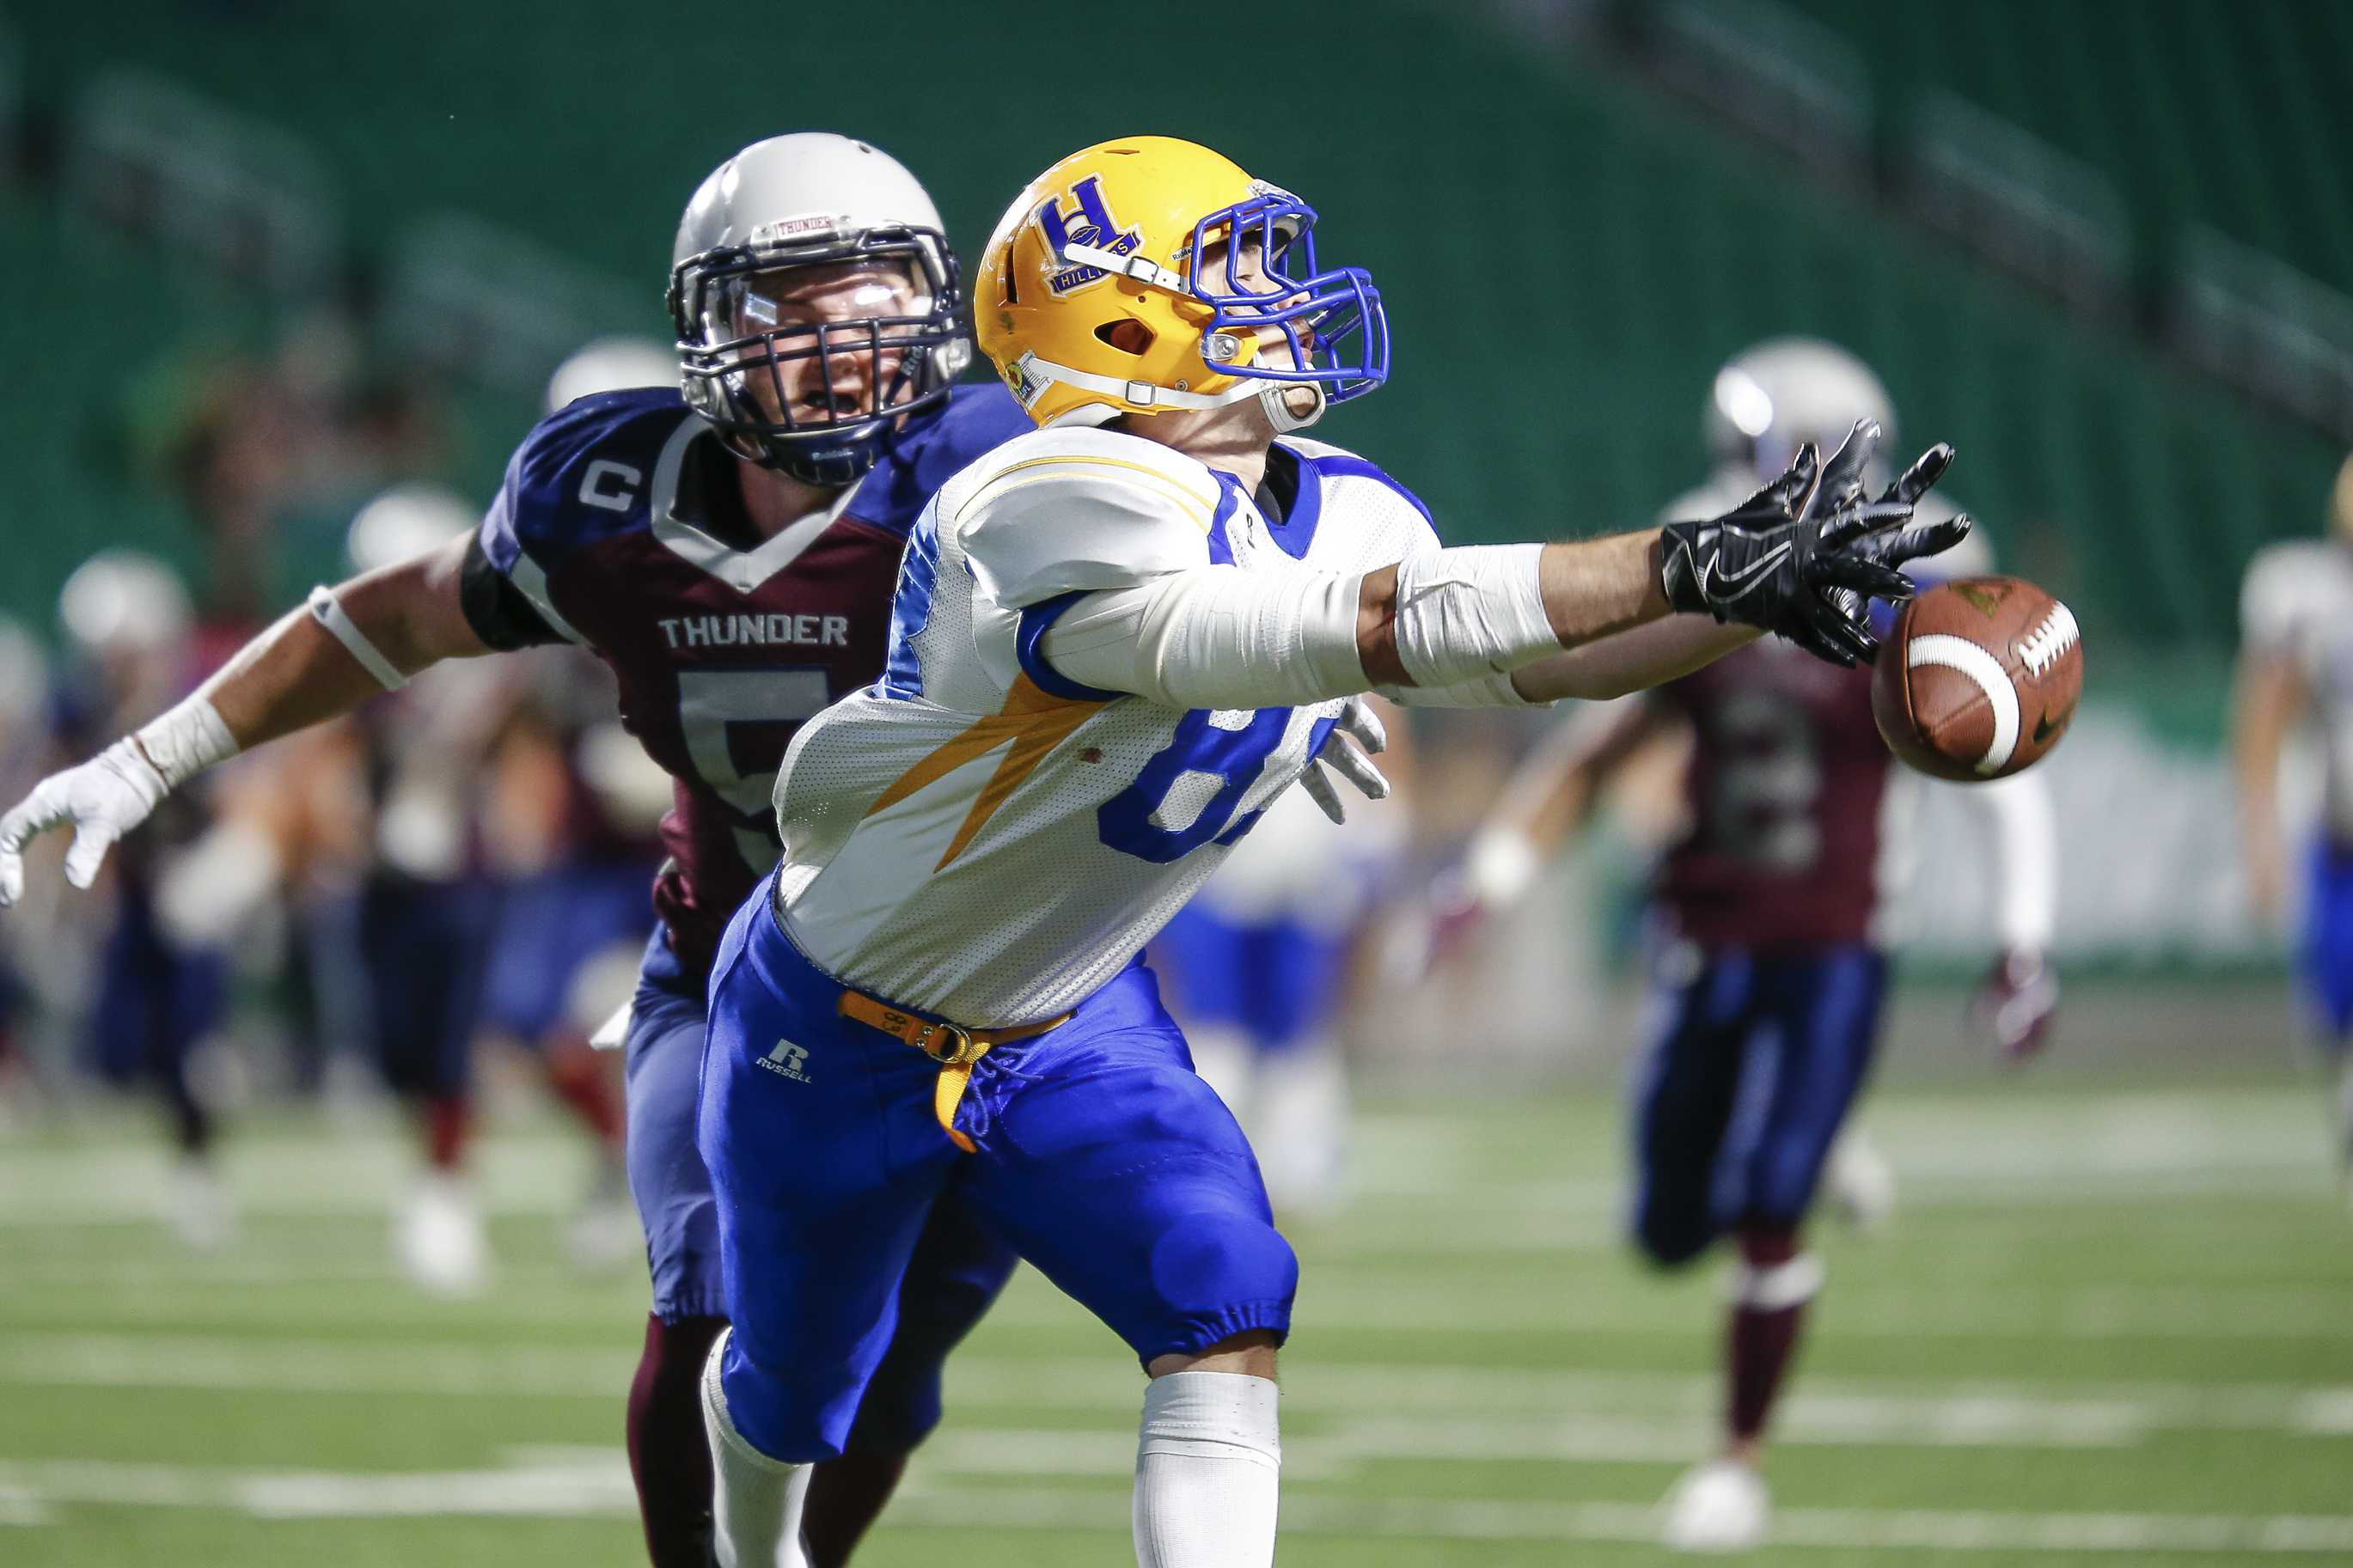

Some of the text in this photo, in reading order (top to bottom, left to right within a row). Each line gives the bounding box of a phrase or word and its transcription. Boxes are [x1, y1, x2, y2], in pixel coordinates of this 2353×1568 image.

[779, 217, 832, 235] THUNDER
[1172, 246, 1193, 260] Ridde
[578, 460, 641, 512] C
[658, 613, 848, 649] THUNDER
[768, 1038, 810, 1072] R
[755, 1057, 812, 1084] RUSSELL
